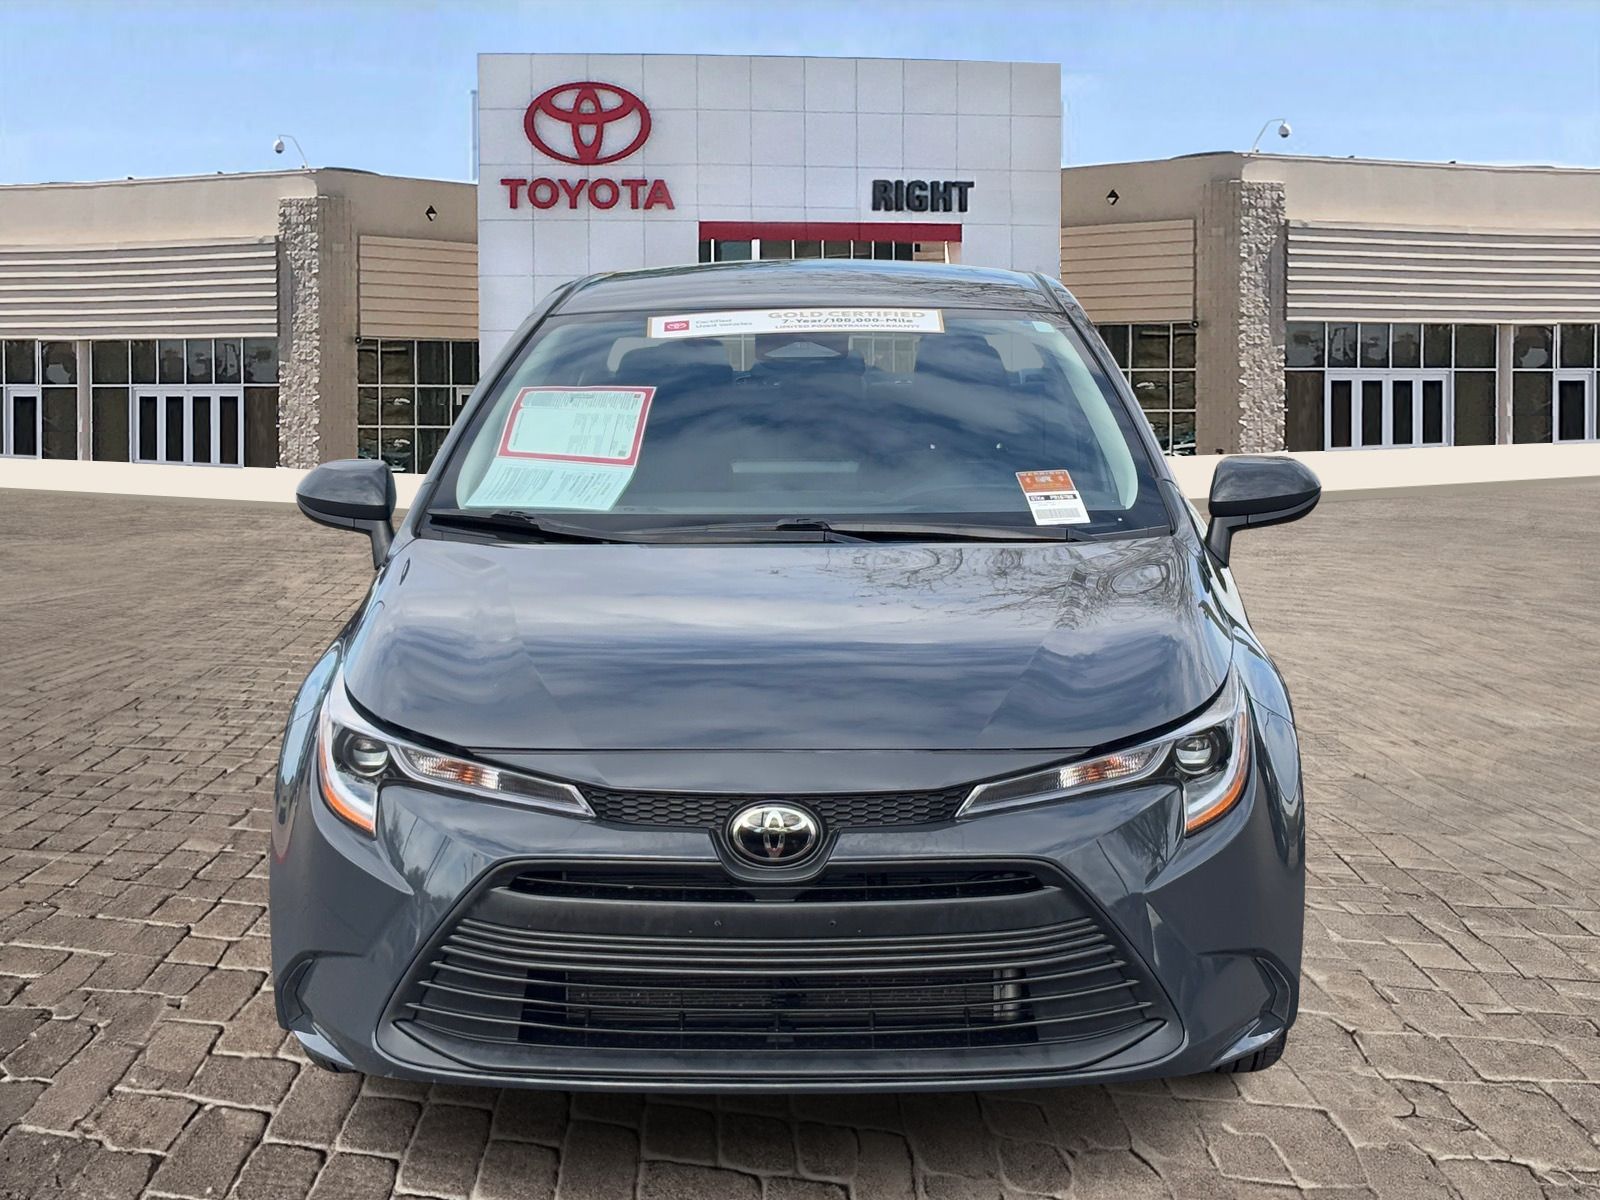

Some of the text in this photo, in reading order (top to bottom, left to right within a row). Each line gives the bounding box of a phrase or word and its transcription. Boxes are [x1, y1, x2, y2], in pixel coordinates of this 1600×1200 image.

[500, 178, 675, 209] TOYOTA
[872, 179, 974, 212] RIGHT
[828, 310, 926, 318] CERTIFIED
